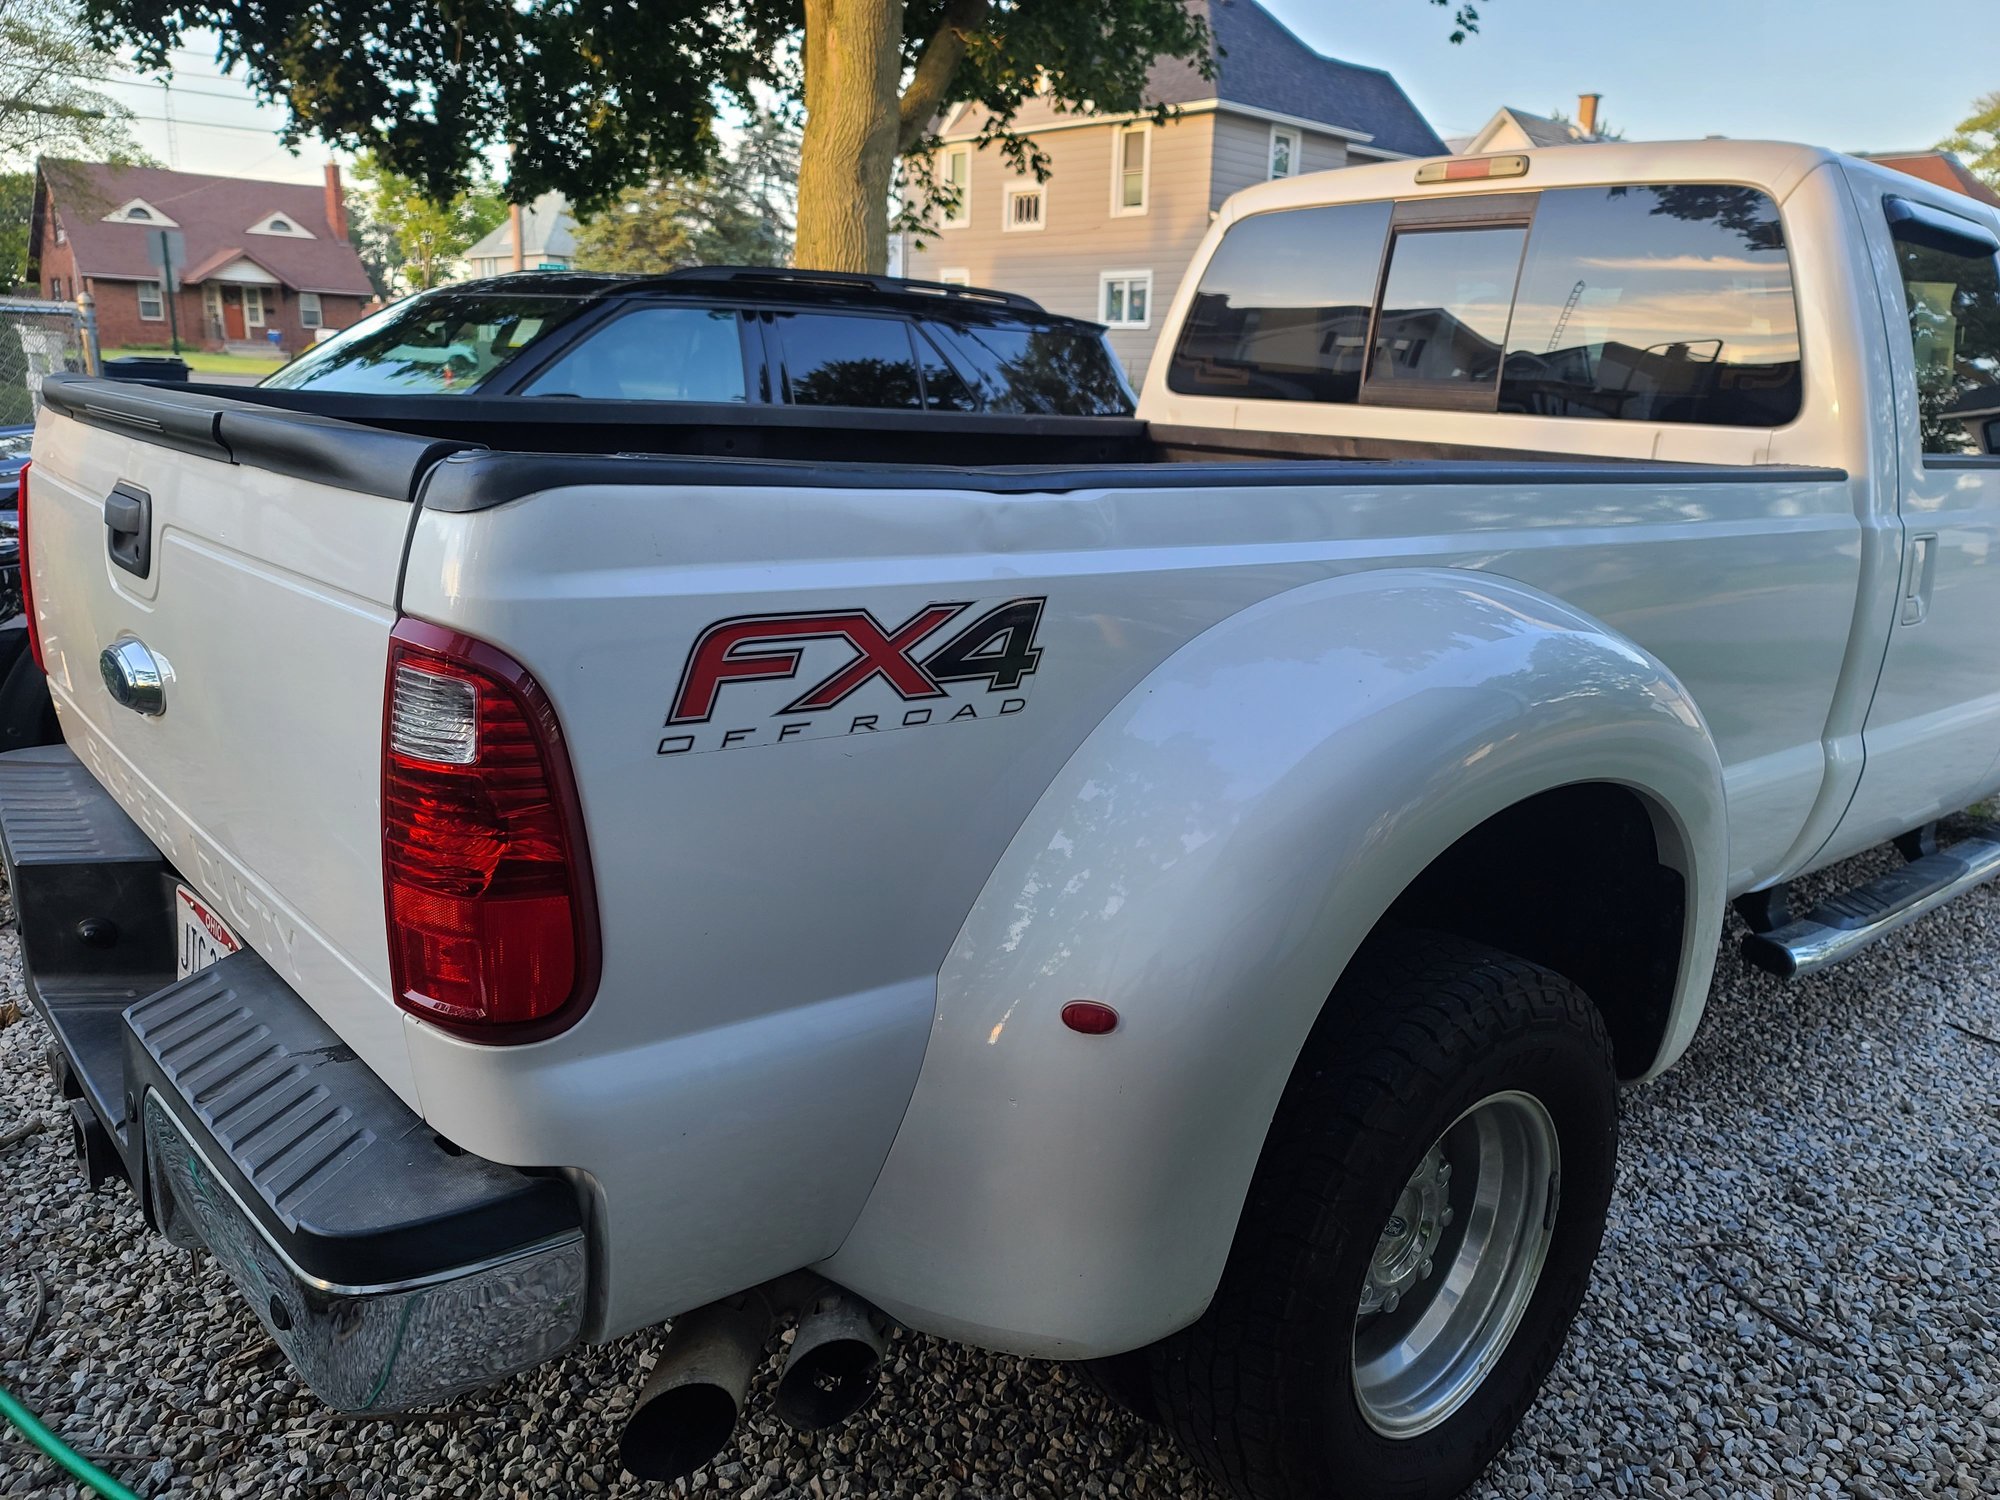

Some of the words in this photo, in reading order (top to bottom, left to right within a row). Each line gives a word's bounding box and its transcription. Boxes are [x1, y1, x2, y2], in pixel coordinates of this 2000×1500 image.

[664, 595, 1048, 726] FX4
[656, 721, 812, 755] OFF
[848, 697, 1027, 734] ROAD
[189, 833, 303, 984] DUTY
[205, 913, 223, 941] OHIO
